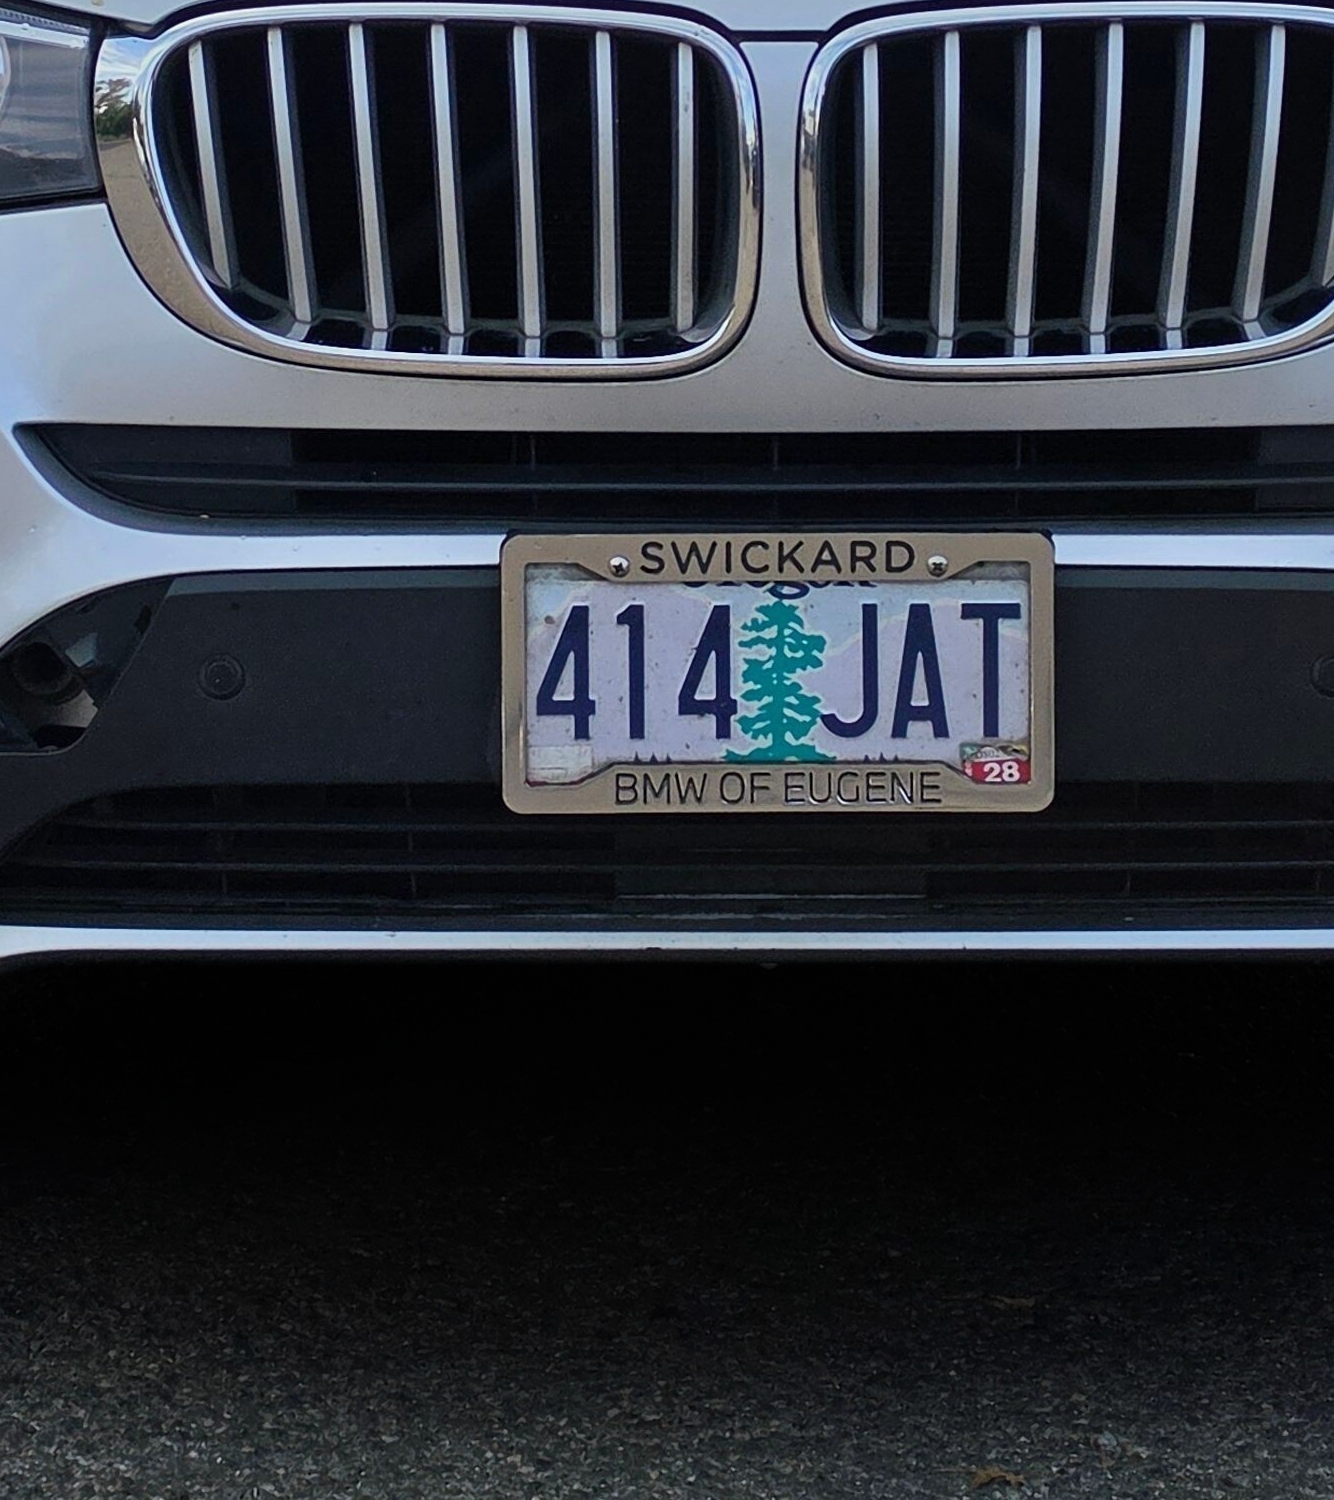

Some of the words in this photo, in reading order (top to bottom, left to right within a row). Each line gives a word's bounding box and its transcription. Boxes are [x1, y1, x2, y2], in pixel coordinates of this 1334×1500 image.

[640, 540, 916, 575] SWICKARD
[535, 604, 738, 740] 414
[820, 602, 1021, 738] JAT
[614, 771, 707, 805] BMW
[720, 771, 771, 805] OF
[783, 771, 942, 805] EUGENE
[983, 761, 1020, 782] 28
